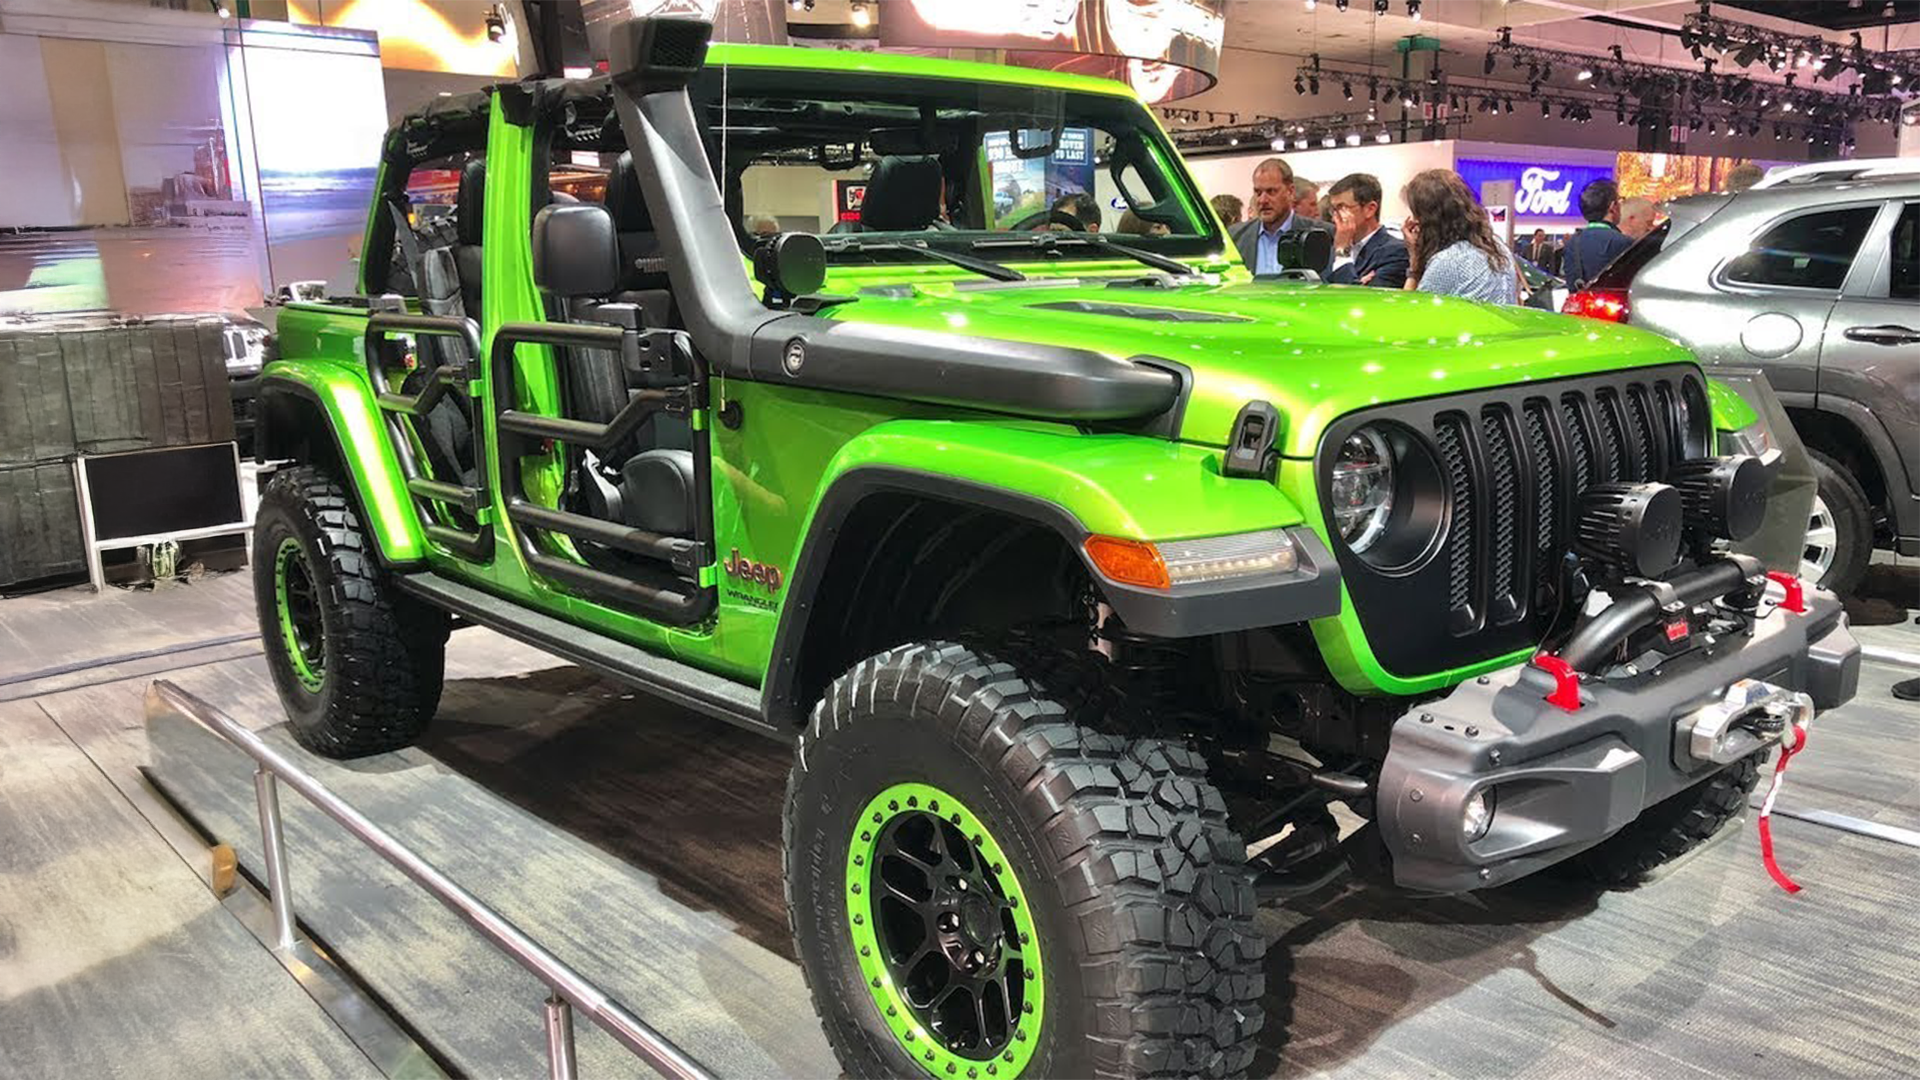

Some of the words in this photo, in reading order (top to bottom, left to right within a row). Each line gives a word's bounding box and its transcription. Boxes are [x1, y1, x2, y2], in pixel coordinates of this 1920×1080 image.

[1066, 150, 1084, 160] LAST
[1514, 167, 1573, 214] Ford
[723, 547, 783, 594] Jeep
